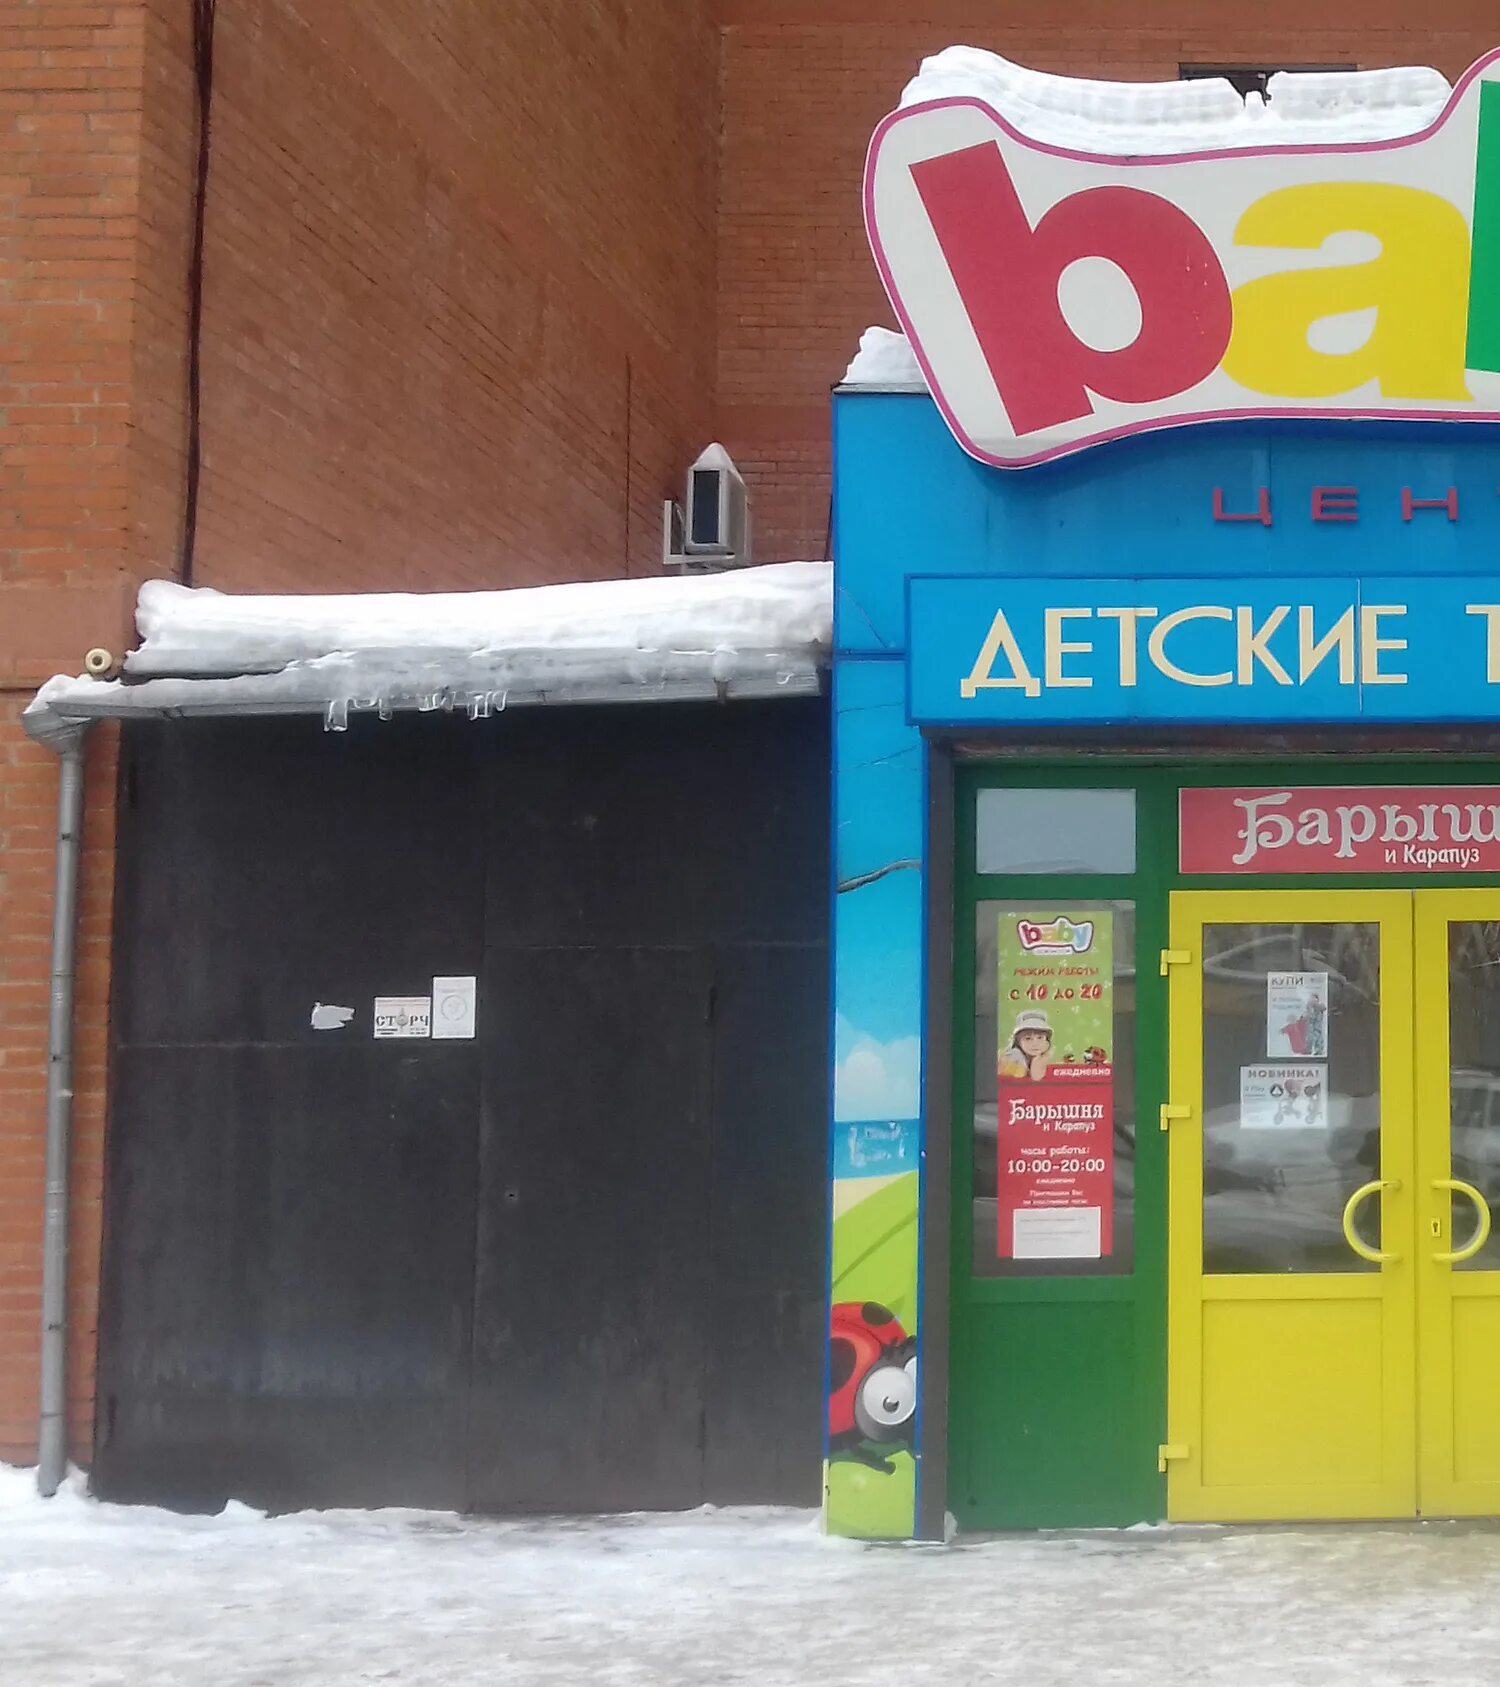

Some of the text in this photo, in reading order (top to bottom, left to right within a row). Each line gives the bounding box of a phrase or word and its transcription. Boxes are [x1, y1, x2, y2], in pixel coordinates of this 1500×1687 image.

[960, 604, 1408, 699] ДЕТСКИЕ
[1384, 843, 1480, 868] и Карапуз
[1021, 919, 1091, 949] baby
[1271, 976, 1304, 986] КУПИ
[1026, 984, 1048, 1000] 10
[1080, 983, 1103, 1000] 20
[1053, 1067, 1111, 1077] ежедневно
[1248, 1069, 1319, 1078] НОВИНКА!
[1008, 1098, 1104, 1125] Барышня
[1043, 1119, 1096, 1133] и Карапуз
[1008, 1159, 1106, 1174] 10:00-20:00
